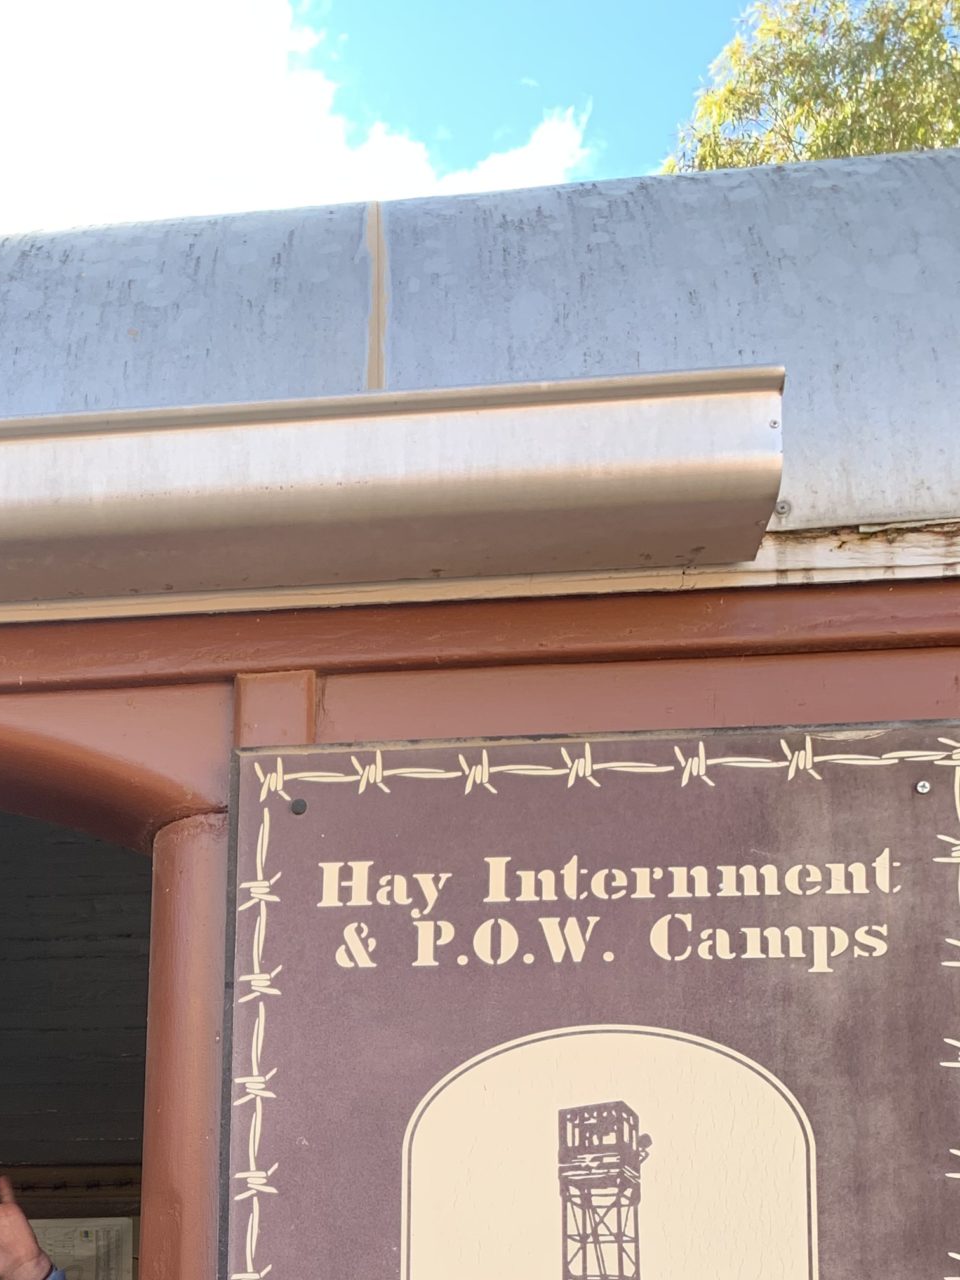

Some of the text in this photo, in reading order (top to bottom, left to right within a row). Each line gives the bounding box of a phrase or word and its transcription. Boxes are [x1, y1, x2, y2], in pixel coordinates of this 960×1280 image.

[317, 845, 902, 920] Hay Internment
[335, 913, 890, 974] & P.O.W. Camps
